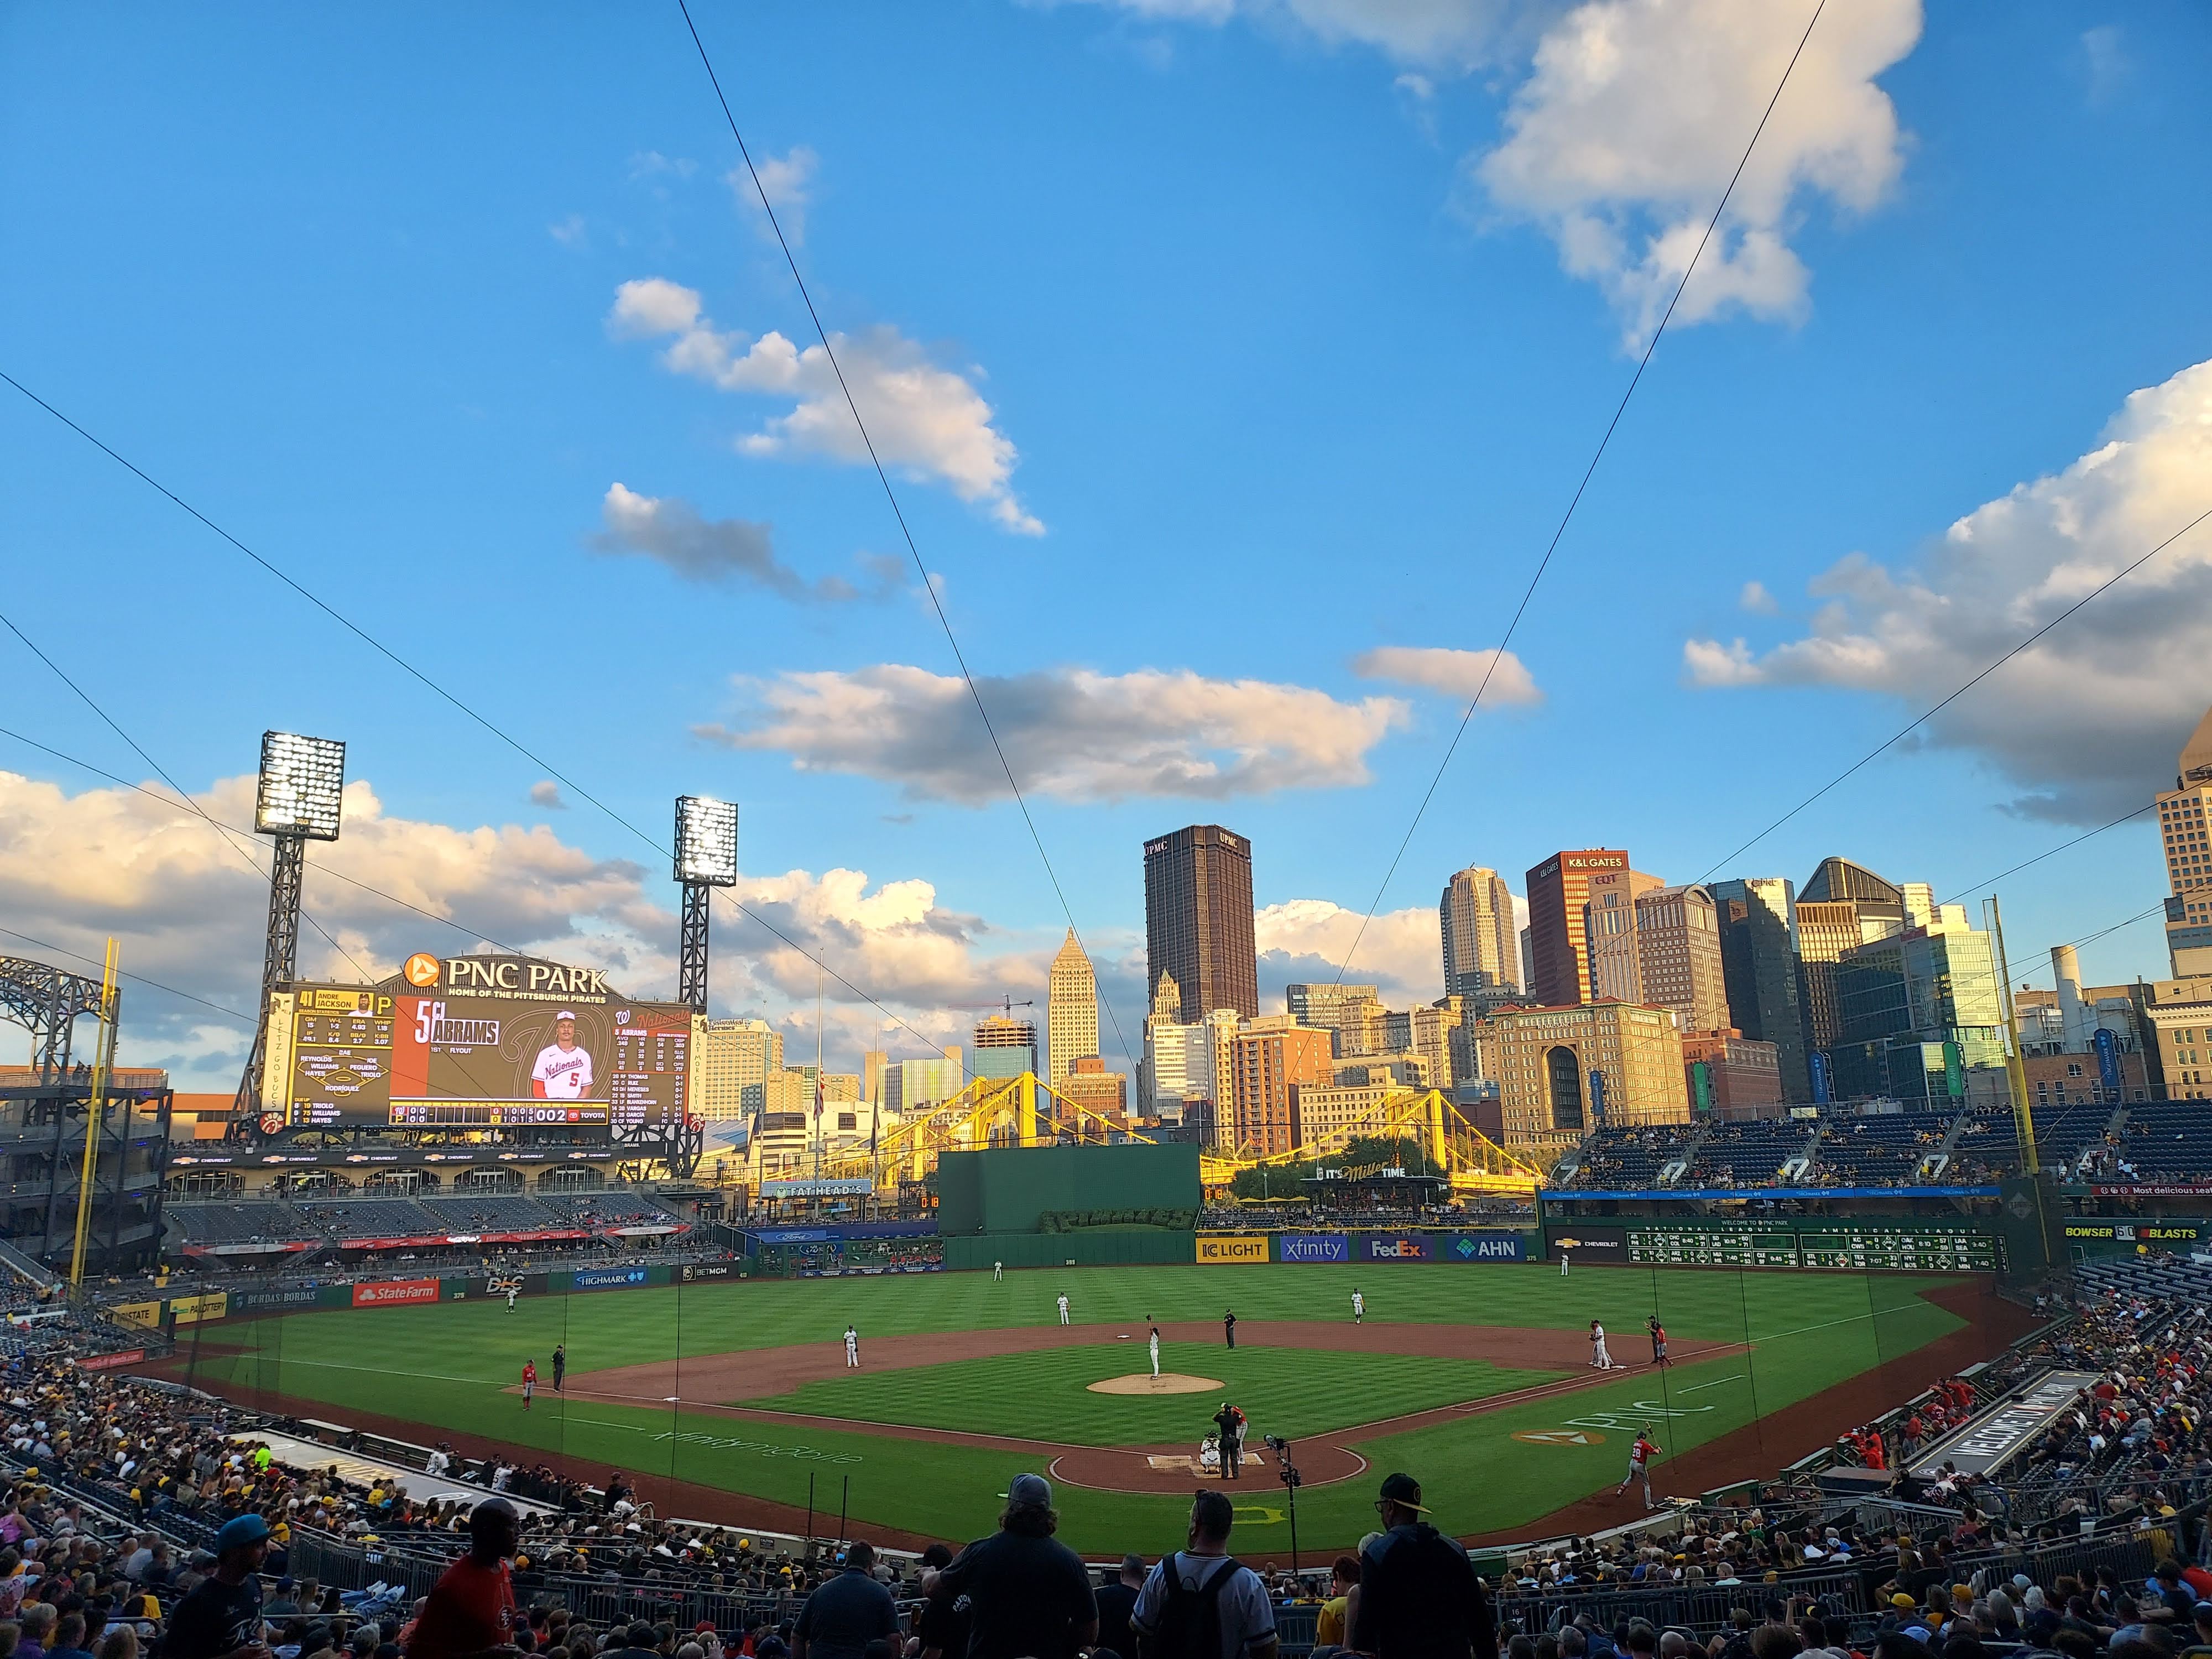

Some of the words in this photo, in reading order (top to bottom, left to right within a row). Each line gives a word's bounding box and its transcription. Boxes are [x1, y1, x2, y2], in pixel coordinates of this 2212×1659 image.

[1219, 832, 1238, 848] UPMC
[1144, 841, 1167, 857] UPMC
[1547, 862, 1559, 874] GATES
[1569, 859, 1588, 868] K&L
[1589, 858, 1623, 867] GATES
[446, 959, 519, 990] PNC
[526, 965, 609, 994] PARK
[300, 991, 313, 1006] 41
[448, 988, 476, 997] HOME
[494, 991, 512, 999] THE
[513, 992, 569, 1002] PITTSBURGH
[571, 995, 606, 1005] PIRATES
[377, 997, 391, 1015] P
[415, 1000, 431, 1044] 5
[615, 1009, 630, 1025] W
[637, 1010, 691, 1029] Nationals
[433, 1021, 497, 1044] ABRAMS
[545, 1057, 583, 1079] Nationals
[569, 1072, 580, 1087] 5
[1327, 1169, 1343, 1179] IT'S
[1340, 1162, 1386, 1182] Miller
[1383, 1168, 1405, 1178] TIME
[790, 1187, 811, 1197] FAT
[815, 1185, 862, 1196] HEAD'S
[1205, 1189, 1223, 1199] 0:18
[921, 1197, 939, 1208] 0:18
[2065, 1227, 2113, 1238] BOWSER
[2149, 1228, 2197, 1239] BLASTS
[1202, 1244, 1218, 1257] IC
[1221, 1244, 1262, 1257] LIGHT
[1287, 1239, 1342, 1260] xfinity
[1371, 1240, 1421, 1258] FedEx
[1478, 1241, 1516, 1256] AHN
[582, 1275, 627, 1286] HIGHMARK
[248, 1294, 280, 1305] BORDAS
[283, 1292, 316, 1302] BORDAS
[190, 1305, 199, 1314] PA
[200, 1302, 226, 1313] OTTERY
[2039, 1383, 2078, 1396] PARK
[2023, 1394, 2065, 1410] PNC
[1561, 1400, 1715, 1431] PNC
[2001, 1410, 2046, 1420] TO
[1949, 1418, 2035, 1457] WELCOME
[1632, 1447, 1641, 1458] 28
